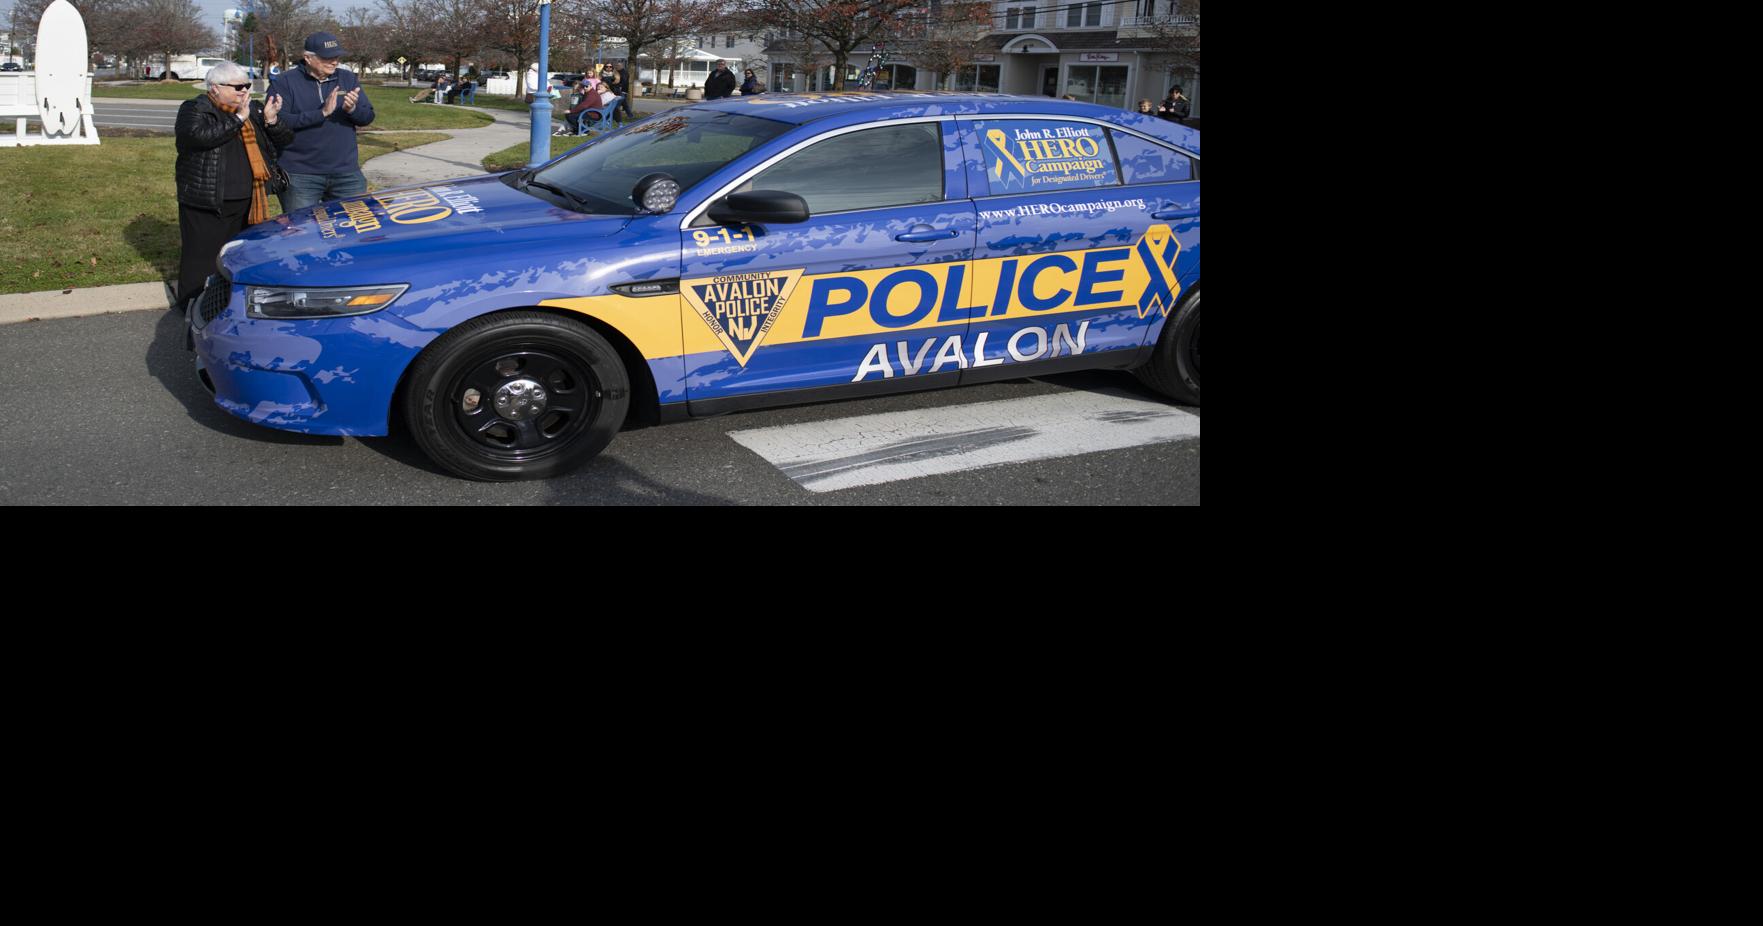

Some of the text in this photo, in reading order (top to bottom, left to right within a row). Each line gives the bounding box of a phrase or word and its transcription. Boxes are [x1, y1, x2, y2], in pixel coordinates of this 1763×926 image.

[1014, 127, 1090, 141] John R. Elliott
[1016, 136, 1099, 161] HERO
[1025, 157, 1104, 175] Campaign
[1031, 177, 1042, 187] for
[1042, 173, 1080, 185] Designated
[978, 198, 1146, 220] www.HEROcampaign.org
[692, 226, 756, 247] 9-1-1
[697, 243, 758, 257] EMERGENCY
[713, 272, 771, 284] COMMUNITY
[704, 278, 779, 303] AVALON
[801, 247, 1131, 339] POLICE
[715, 297, 770, 319] POLICE
[760, 296, 786, 333] INTEGRITY
[702, 311, 724, 335] HONOR
[728, 316, 758, 341] NJ
[851, 320, 1091, 382] AVALON
